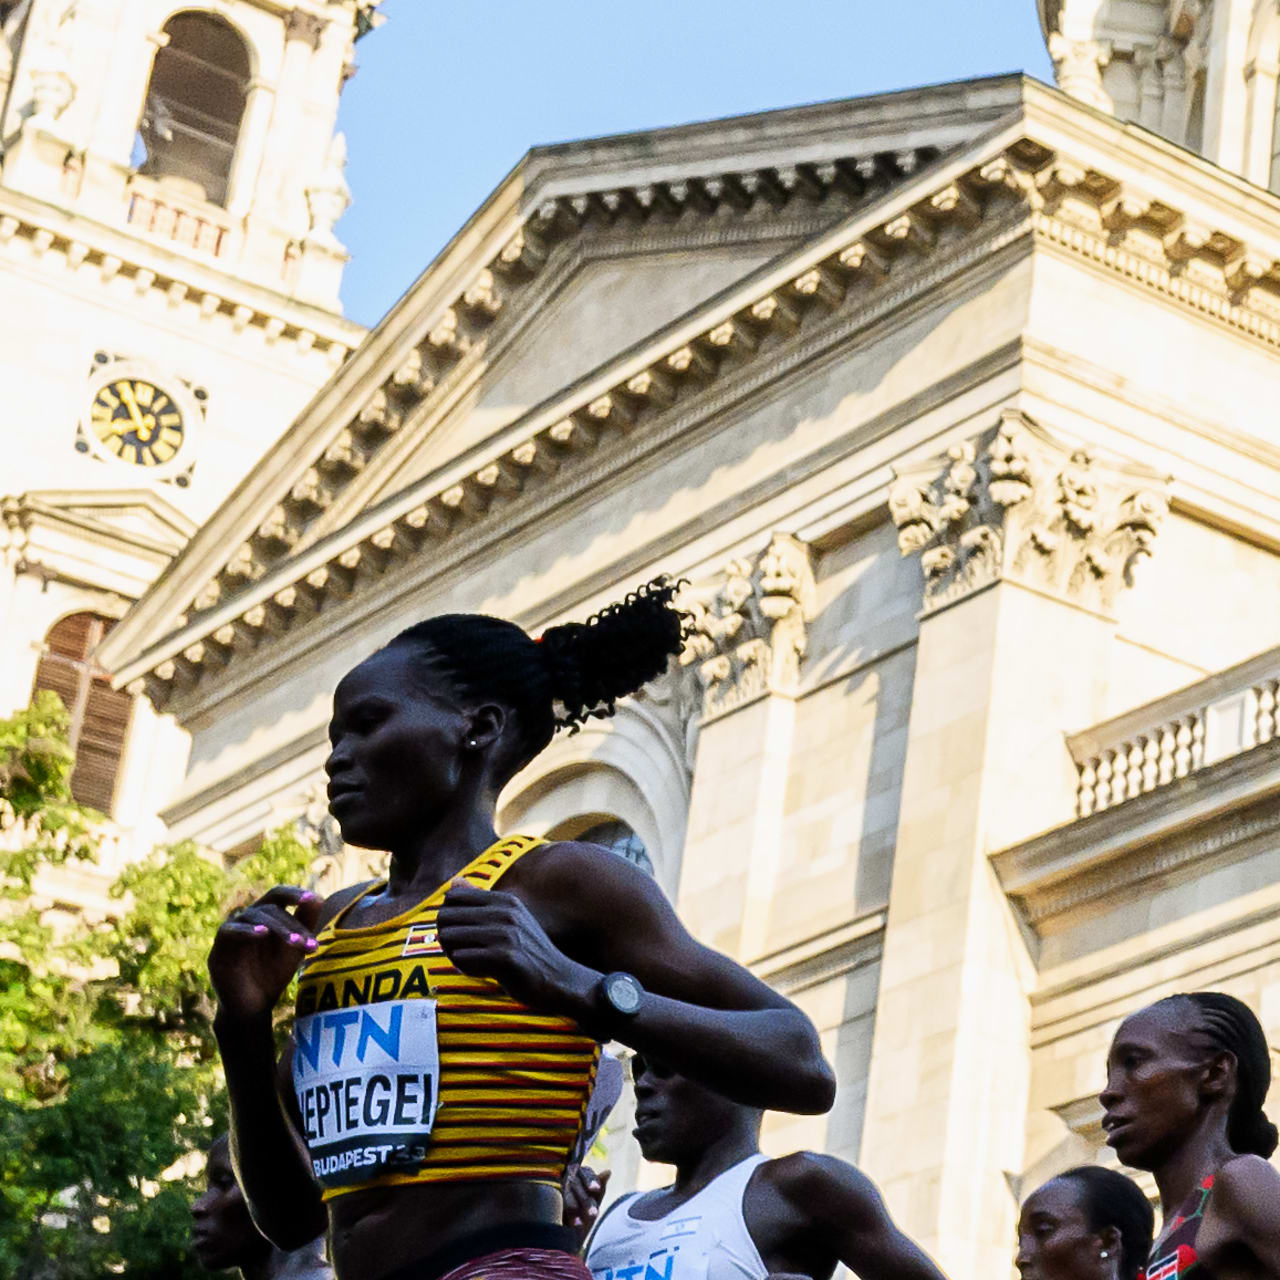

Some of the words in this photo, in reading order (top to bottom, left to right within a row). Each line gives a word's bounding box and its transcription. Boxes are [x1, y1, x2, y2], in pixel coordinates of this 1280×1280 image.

[298, 965, 430, 1017] GANDA
[301, 1073, 432, 1140] EPTEGEI
[313, 1144, 393, 1177] BUDAPEST
